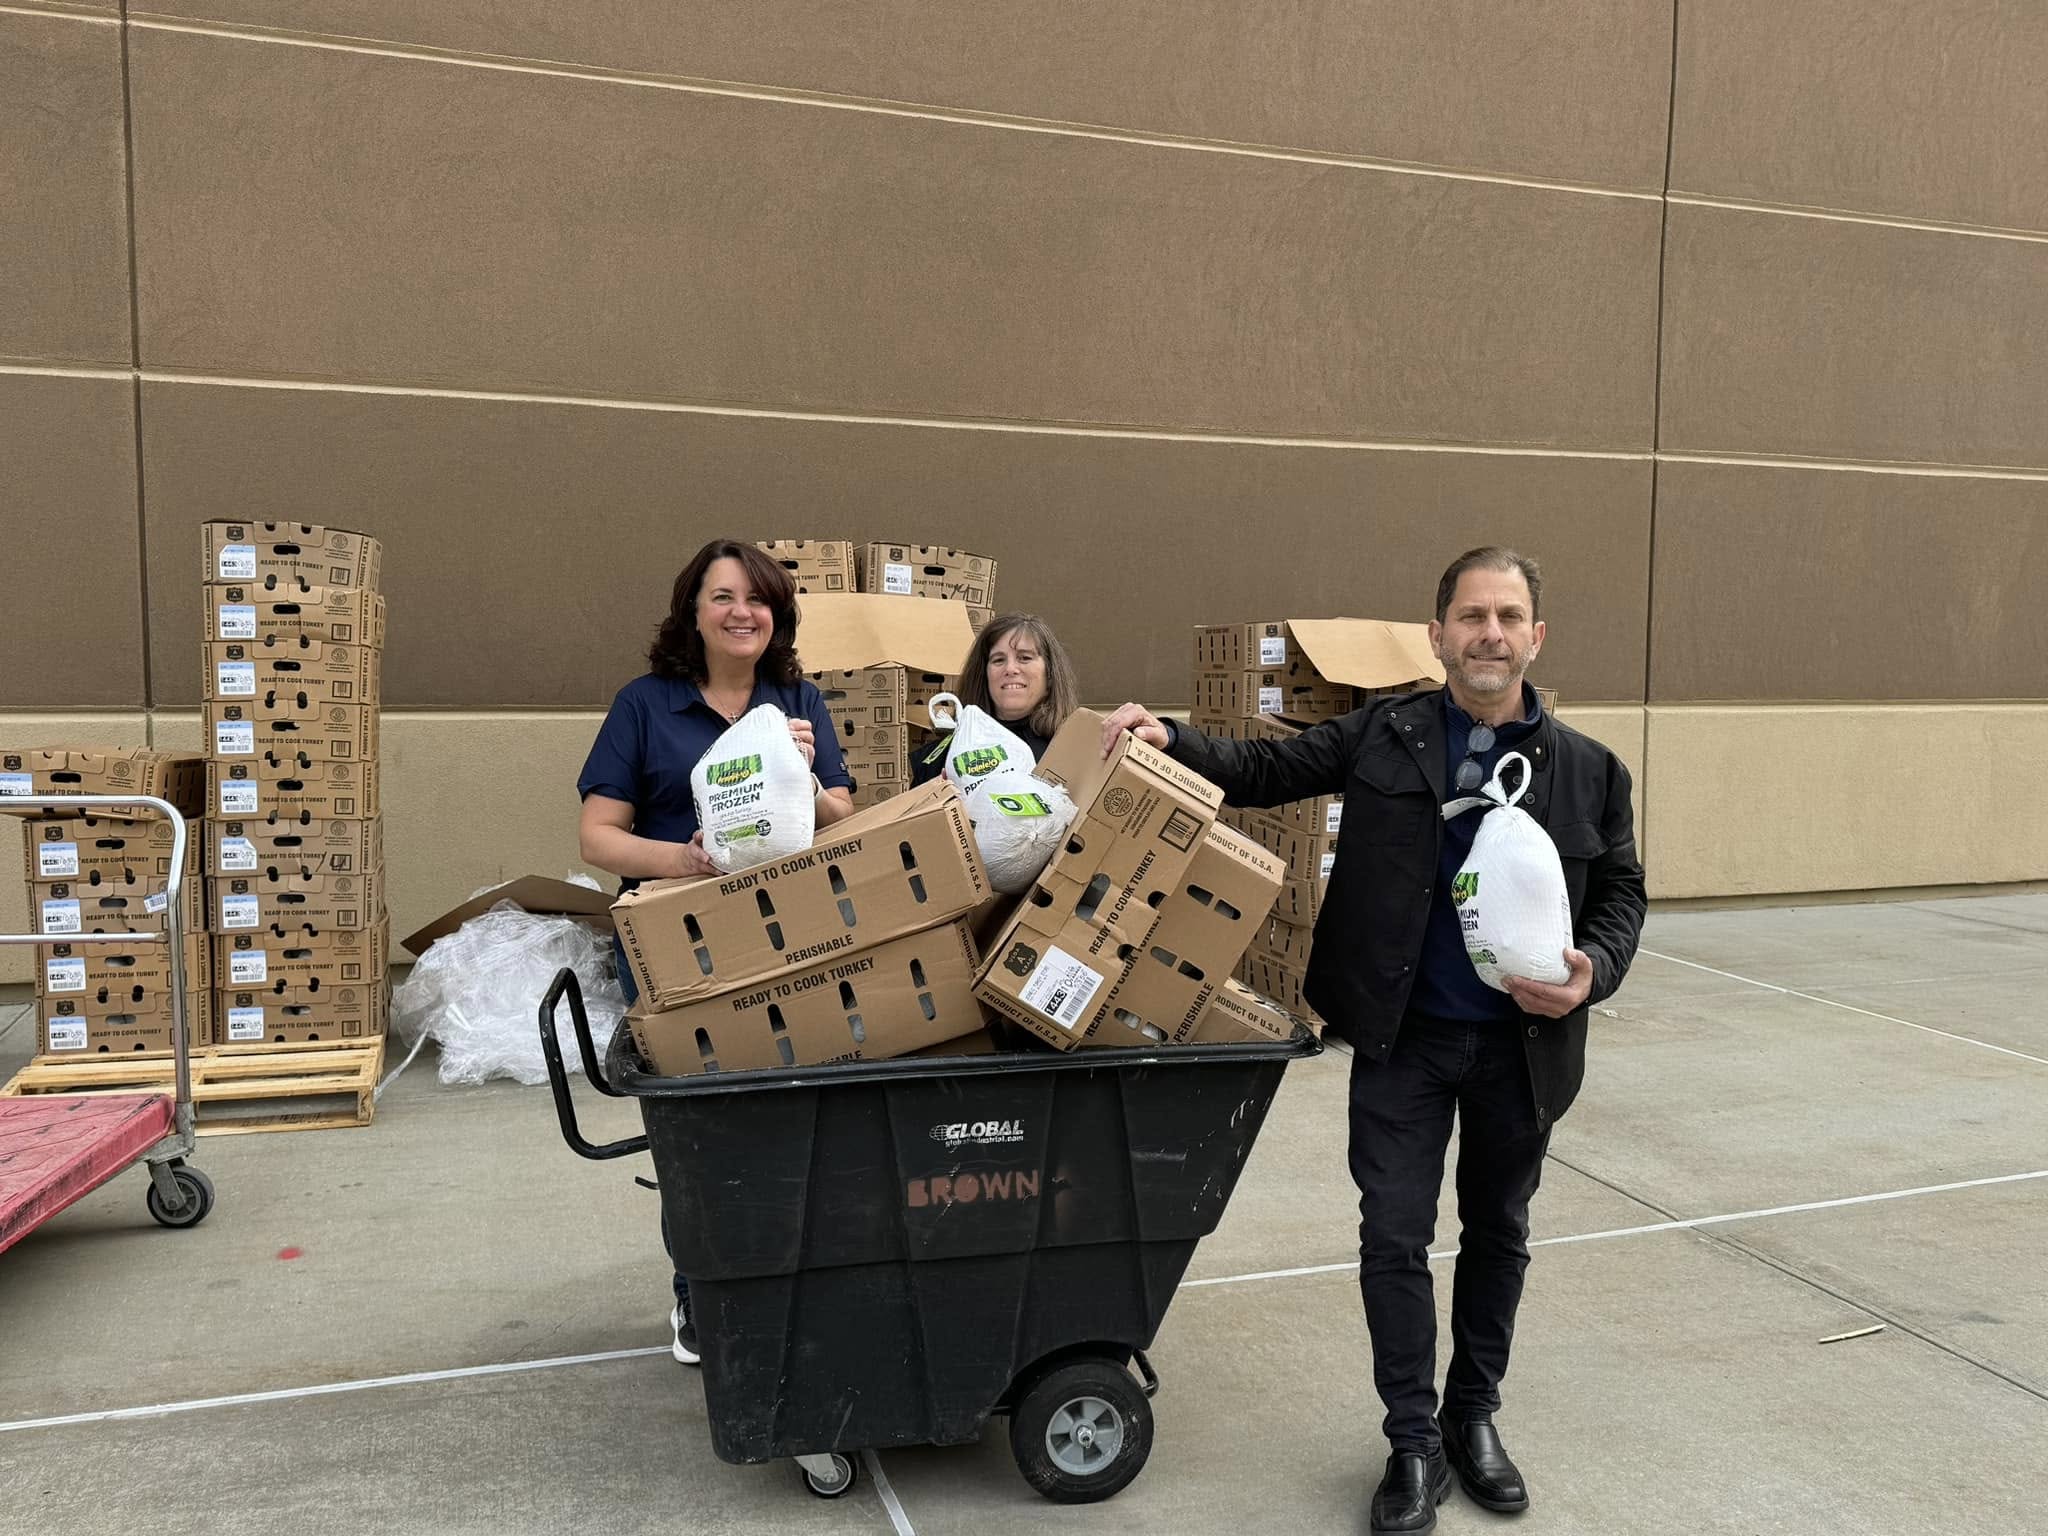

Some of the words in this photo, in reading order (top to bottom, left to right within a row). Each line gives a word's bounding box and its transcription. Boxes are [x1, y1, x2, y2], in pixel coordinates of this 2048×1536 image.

[1135, 746, 1159, 767] U.S.A.
[1159, 764, 1172, 775] OF
[708, 781, 764, 804] PREMIUM
[711, 792, 761, 814] FROZEN
[1172, 771, 1213, 799] PRODUCT
[720, 873, 758, 896] READY
[761, 867, 778, 881] TO
[781, 855, 816, 875] COOK
[816, 838, 864, 863] TURKEY
[950, 807, 969, 850] PRODUCT
[964, 851, 973, 864] OF
[969, 864, 982, 894] U.S.A.
[1206, 830, 1239, 853] RODUCT
[1239, 848, 1250, 860] OF
[1251, 854, 1274, 874] U.S.A.
[1088, 925, 1111, 955] READY
[1106, 911, 1119, 925] TO
[1115, 884, 1135, 912] COOK
[1130, 849, 1156, 885] TURKEY
[623, 917, 637, 945] U.S.A.
[785, 934, 854, 964] PERISHABLE
[959, 927, 977, 970] PRODUCT
[632, 947, 642, 959] OF
[732, 989, 772, 1012] READY
[774, 983, 791, 998] TO
[793, 972, 828, 992] COOK
[828, 956, 875, 980] TURKEY
[982, 991, 1022, 1018] PRODUCT
[1022, 1016, 1035, 1026] OF
[1035, 1024, 1058, 1044] U.S.A.
[1173, 982, 1214, 1043] PERISHABLE
[1215, 994, 1246, 1017] RODUCT
[1247, 1012, 1260, 1023] OF
[1260, 1018, 1282, 1036] U.S.A.
[946, 1119, 1024, 1140] GLOBAL
[908, 1169, 1039, 1207] BROWN
